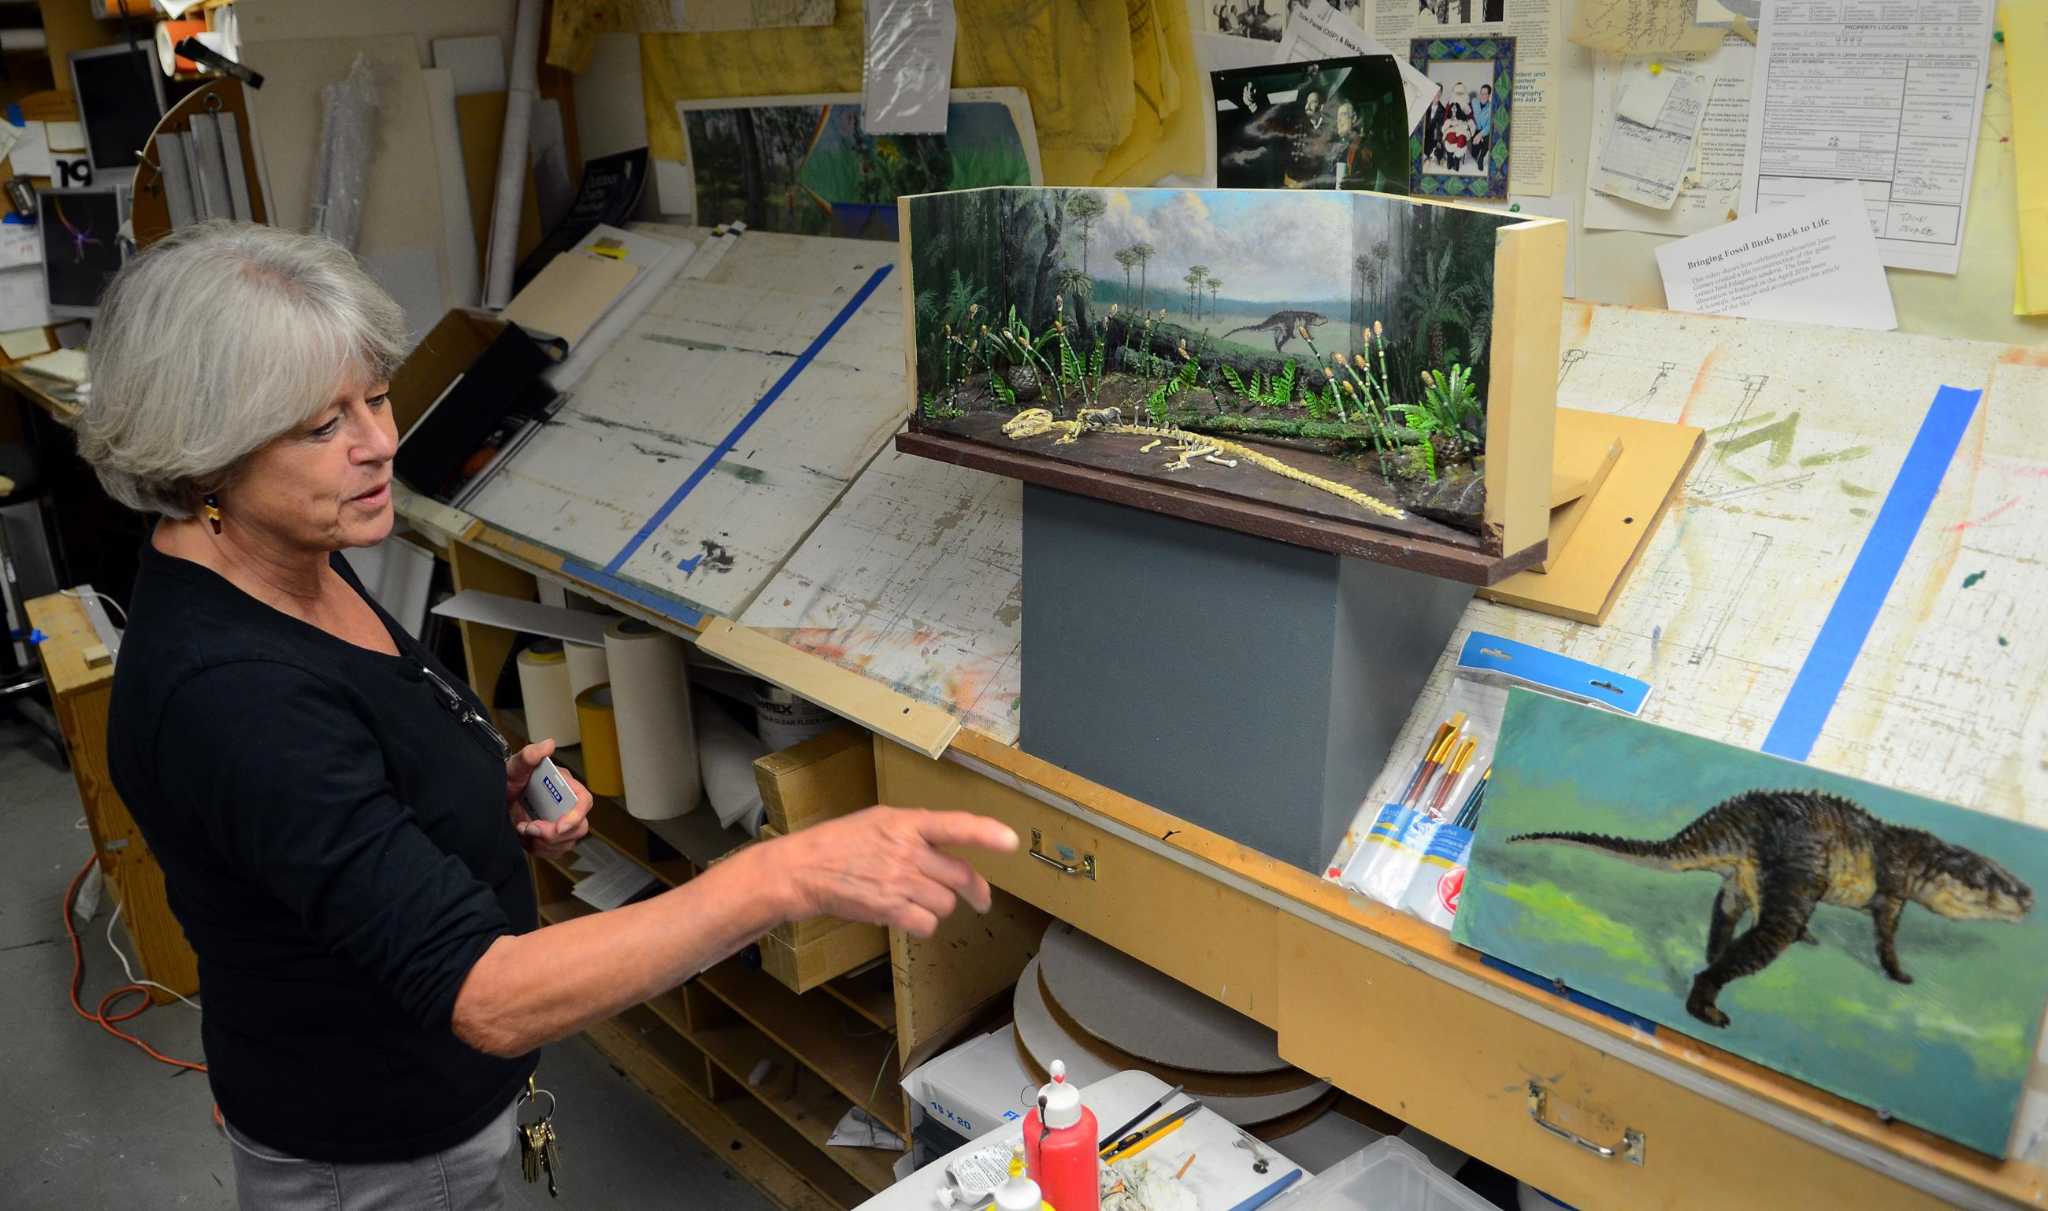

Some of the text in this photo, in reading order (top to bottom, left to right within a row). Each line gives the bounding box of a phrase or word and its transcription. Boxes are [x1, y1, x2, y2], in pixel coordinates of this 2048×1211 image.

[56, 159, 92, 187] 19
[1688, 217, 1831, 269] Bringing Fossil Birds Back to Life
